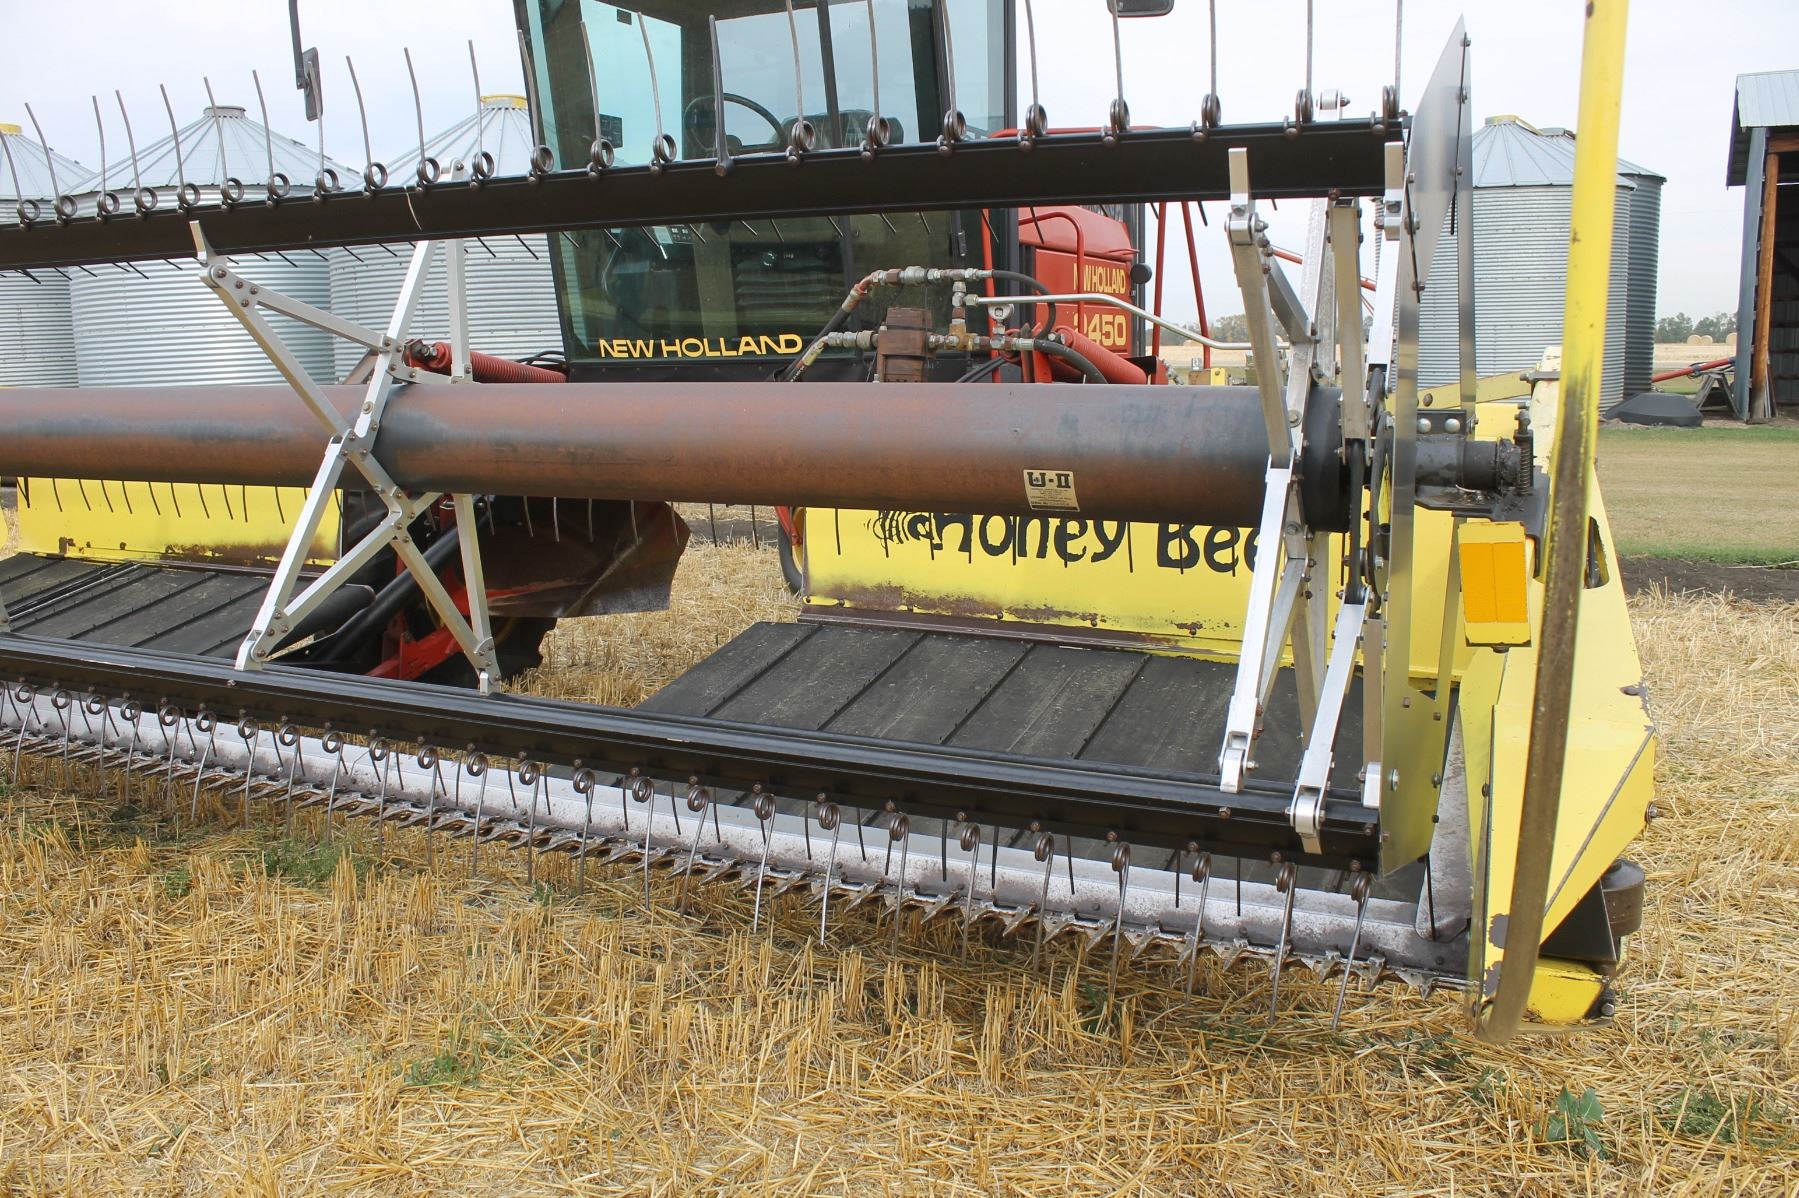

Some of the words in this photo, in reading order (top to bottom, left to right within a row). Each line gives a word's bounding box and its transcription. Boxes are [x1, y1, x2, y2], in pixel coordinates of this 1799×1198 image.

[1073, 263, 1092, 292] NW
[1092, 266, 1126, 295] HOLLAND
[600, 339, 654, 358] NEW
[661, 334, 803, 358] HOLLAND
